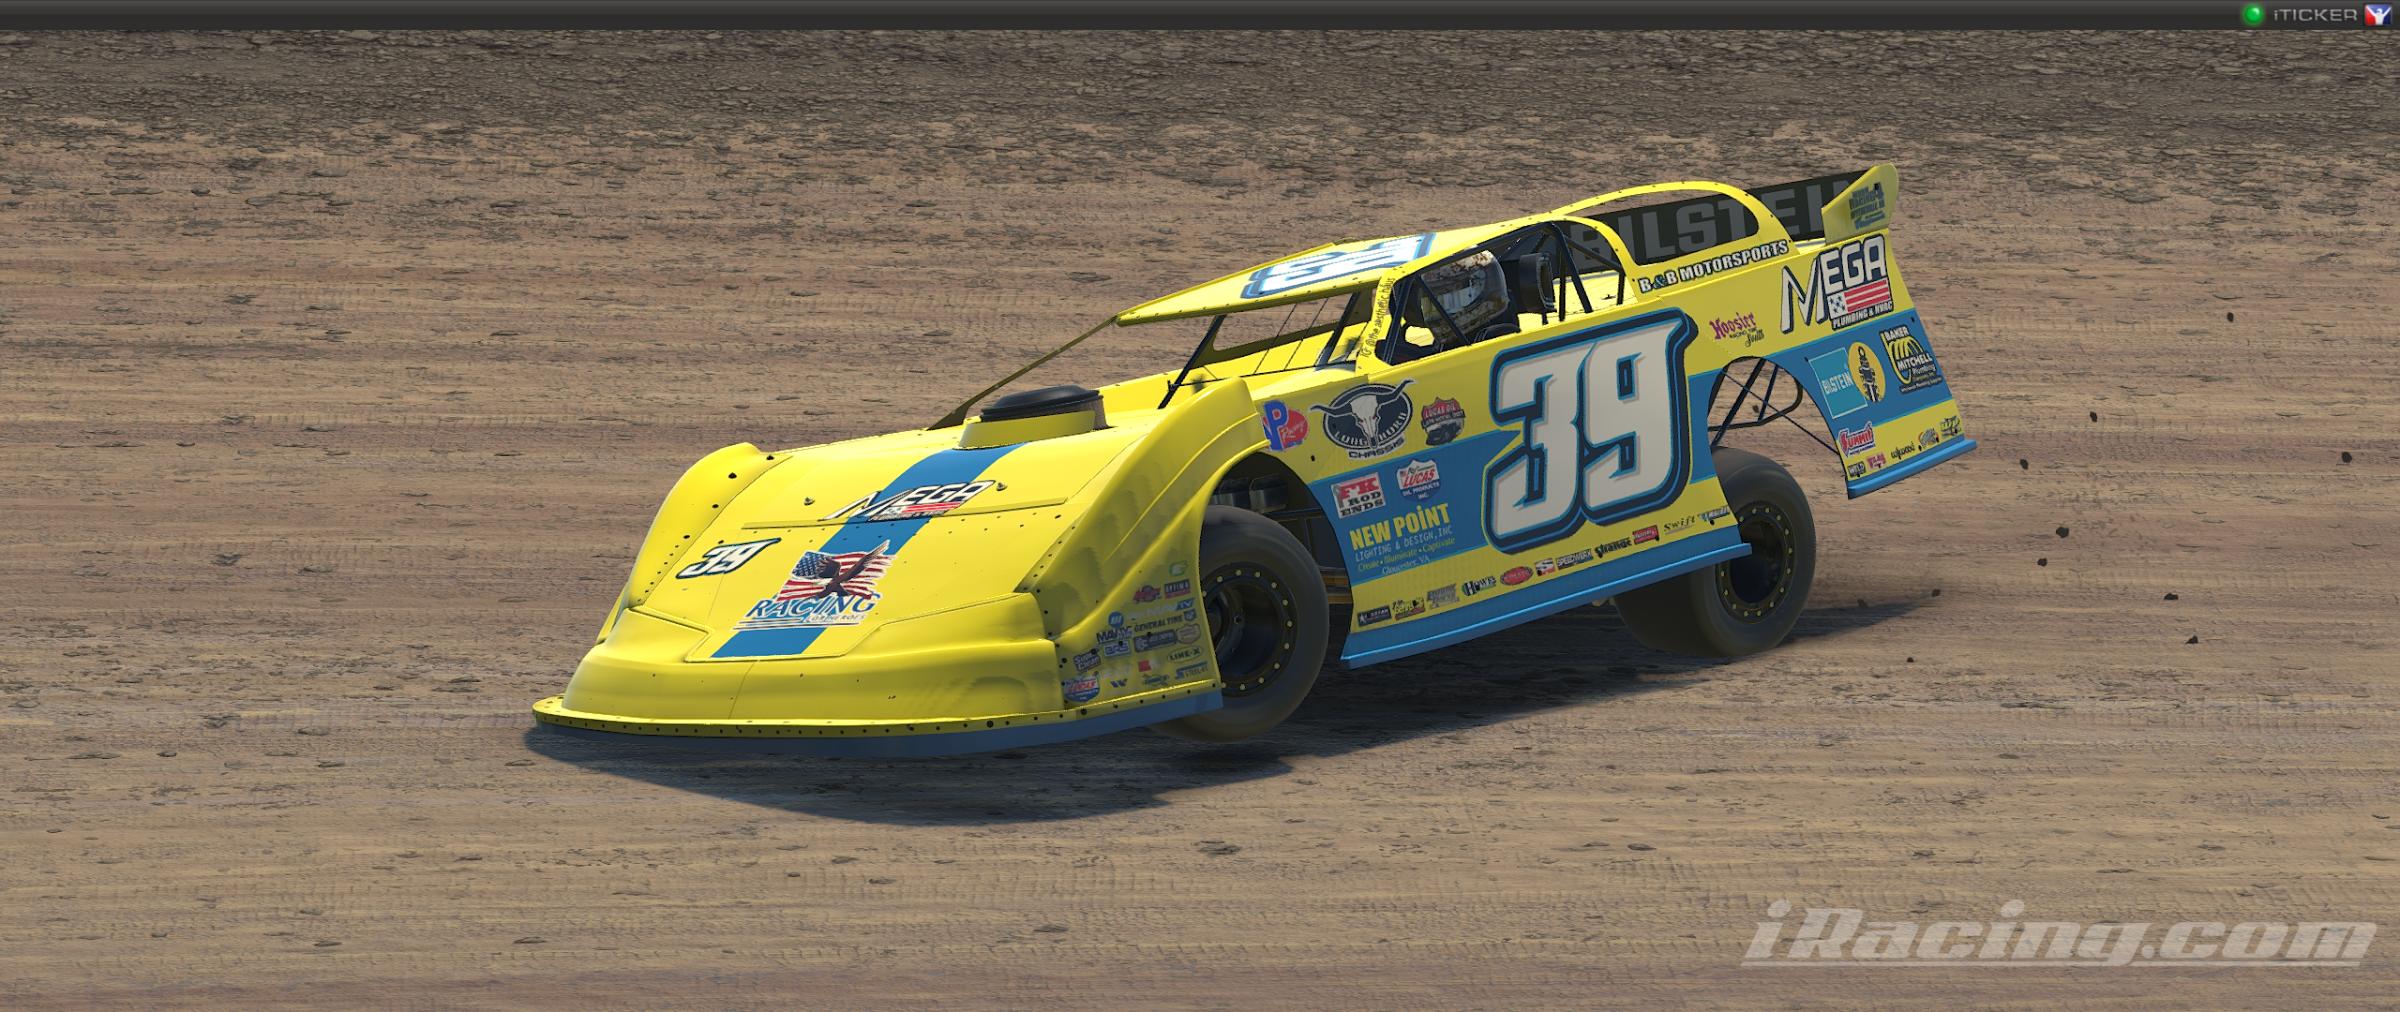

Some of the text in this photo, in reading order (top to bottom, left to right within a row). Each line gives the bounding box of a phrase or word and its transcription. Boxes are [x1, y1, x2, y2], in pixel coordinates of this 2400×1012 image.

[1638, 239, 1790, 294] B&B MOTORSPORTS
[1780, 233, 1888, 335] MEGA
[1708, 311, 1757, 340] Hoosier
[1884, 326, 1910, 341] BAKER
[1897, 353, 1933, 371] MITCHELL
[1821, 370, 1854, 395] BILSTEIN
[1486, 311, 1692, 550] 39
[1839, 425, 1875, 456] SUMMIT
[1348, 436, 1405, 459] CHASSIS
[1338, 478, 1380, 498] FK
[1403, 468, 1435, 488] LUCAS
[817, 479, 996, 522] MEGA
[1340, 499, 1384, 517] ENDS
[1347, 492, 1382, 506] ROD
[1349, 520, 1392, 551] NEW
[675, 538, 782, 579] 39
[1355, 543, 1392, 562] LIGHTING
[744, 592, 882, 618] RACING
[1135, 618, 1166, 632] GENERAL
